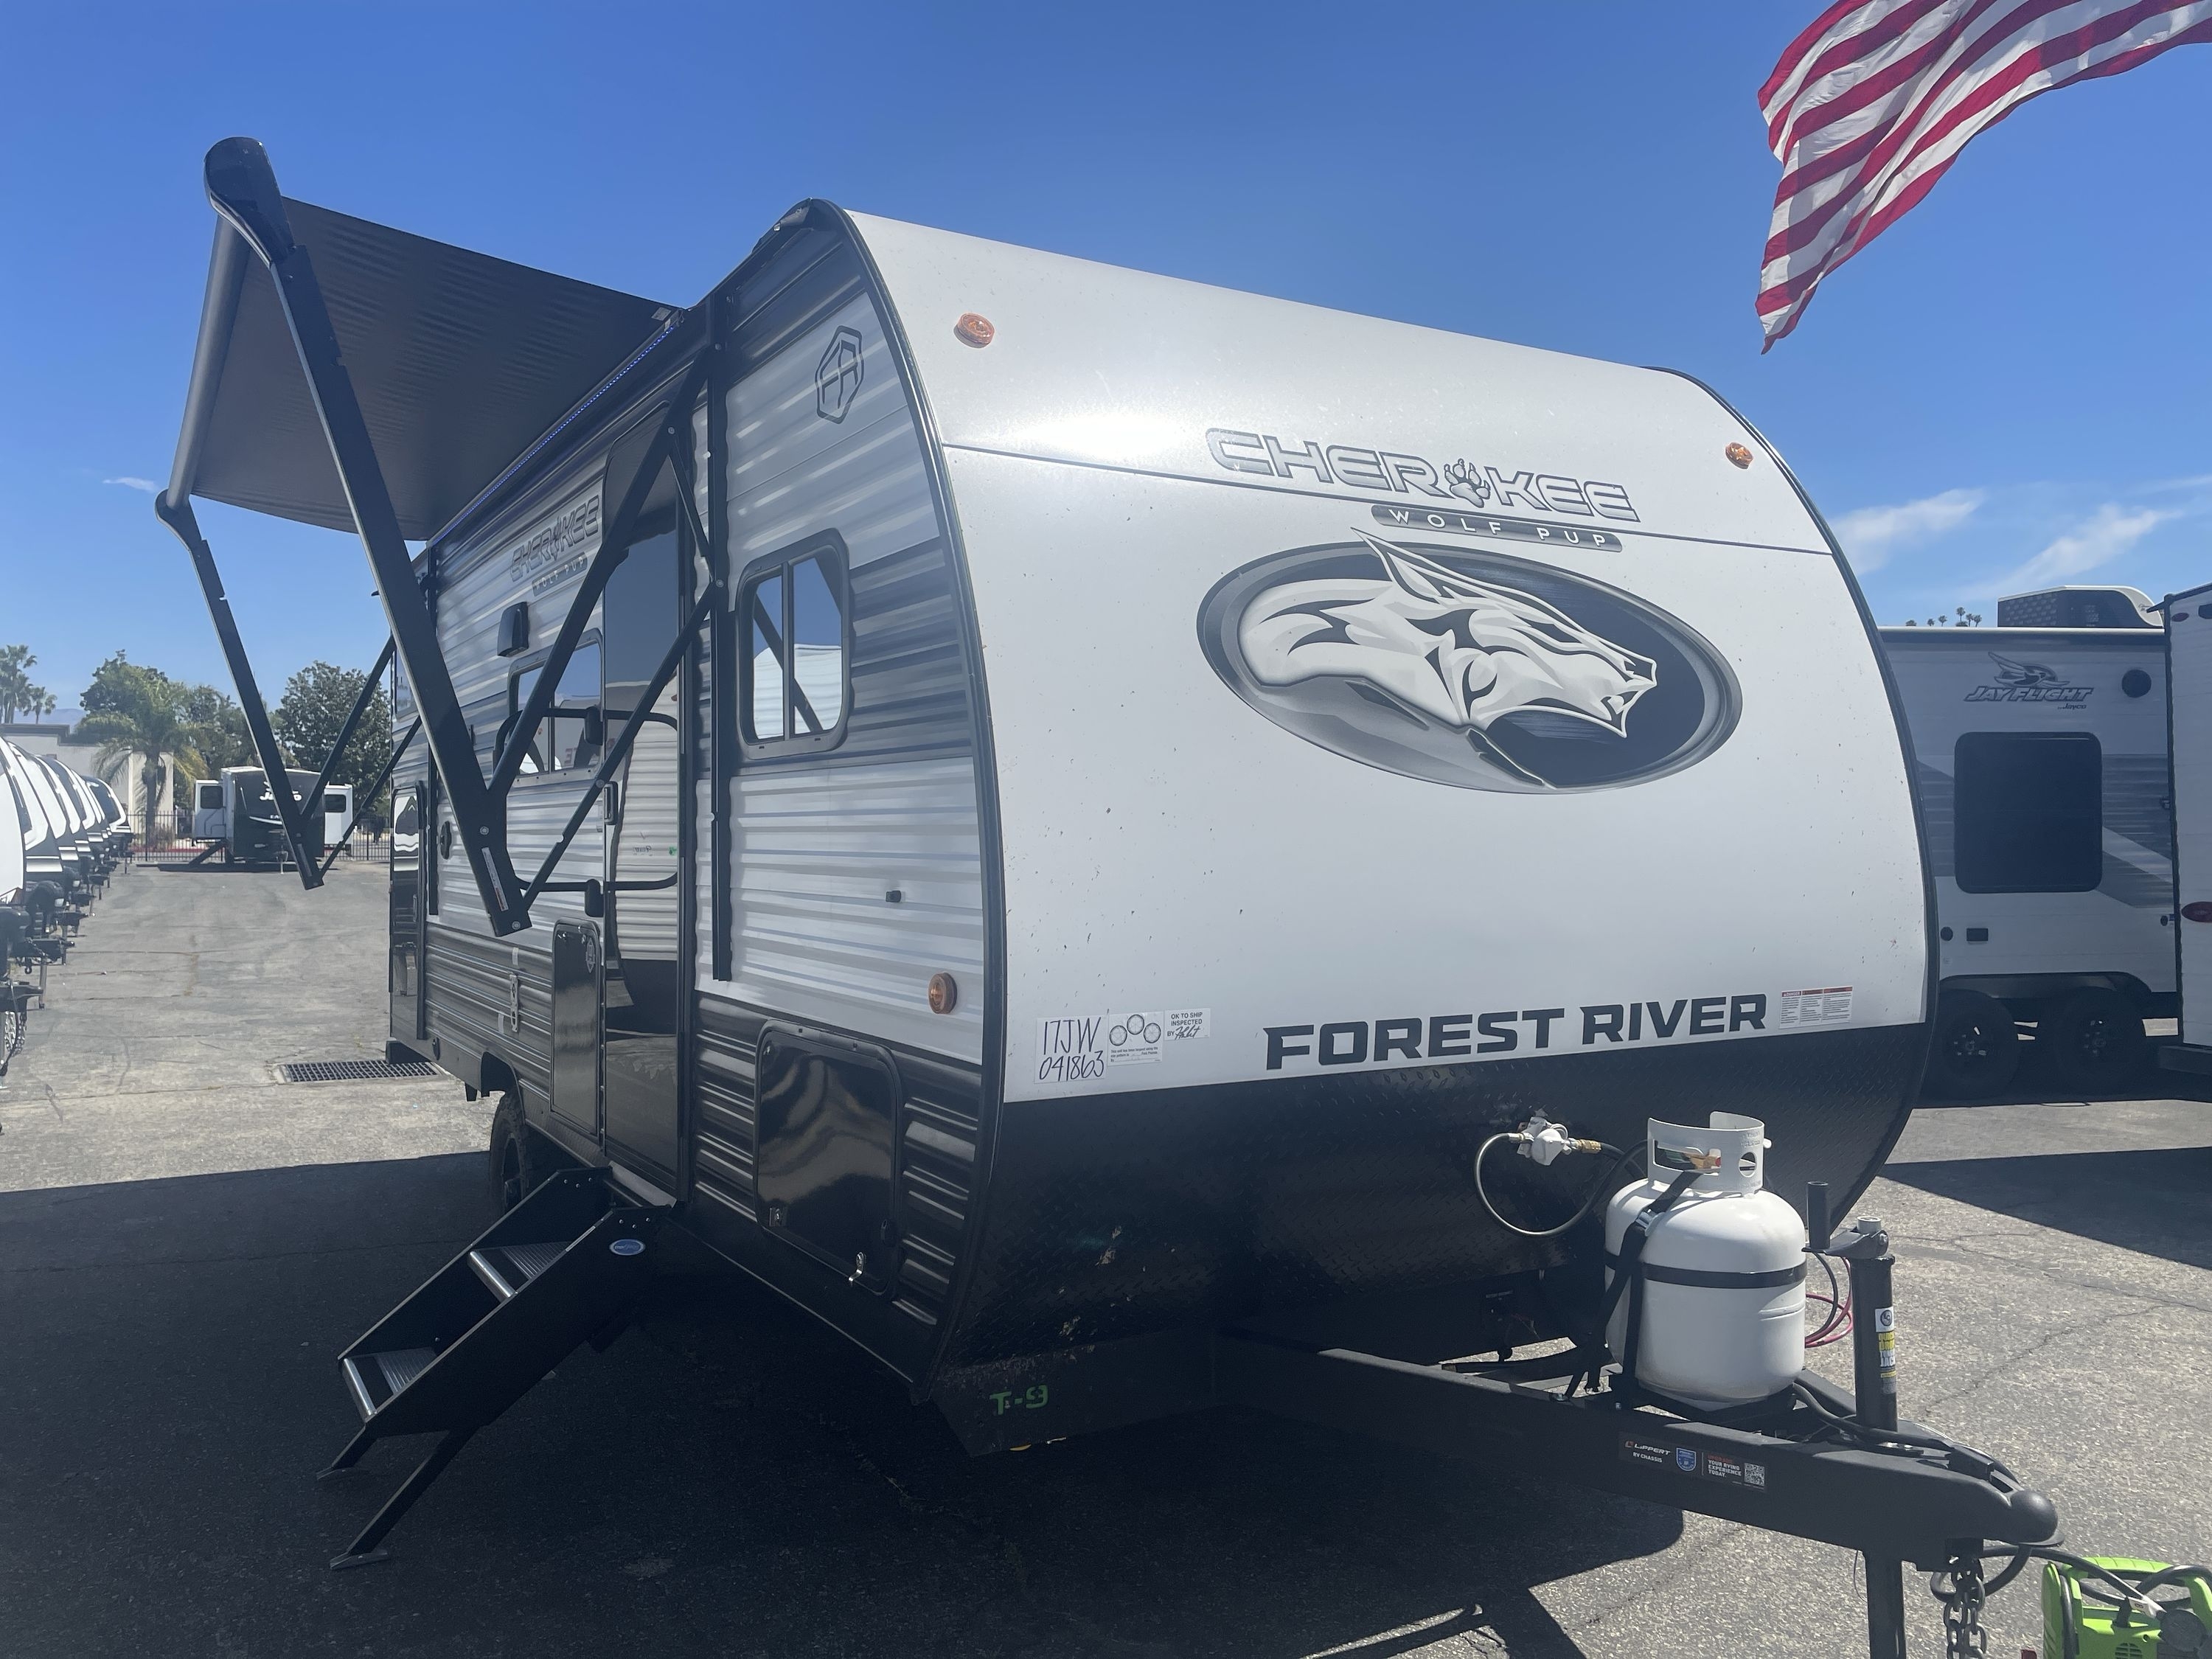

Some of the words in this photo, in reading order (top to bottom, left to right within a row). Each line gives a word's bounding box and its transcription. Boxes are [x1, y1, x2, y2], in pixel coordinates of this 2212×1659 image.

[1388, 508, 1502, 535] WOLF
[1537, 526, 1606, 547] PUP
[535, 570, 559, 589] WOLF
[564, 557, 584, 575] PUP
[1964, 686, 2012, 702] JAY
[2010, 686, 2094, 702] FLIGHT
[1171, 1018, 1203, 1026] INSPECTED
[1262, 1007, 1565, 1070] FOREST
[1579, 993, 1767, 1045] RIVER
[1038, 1050, 1104, 1082] 041863
[1640, 1453, 1663, 1463] CHASSIS
[1708, 1464, 1742, 1476] EXPERIENCE
